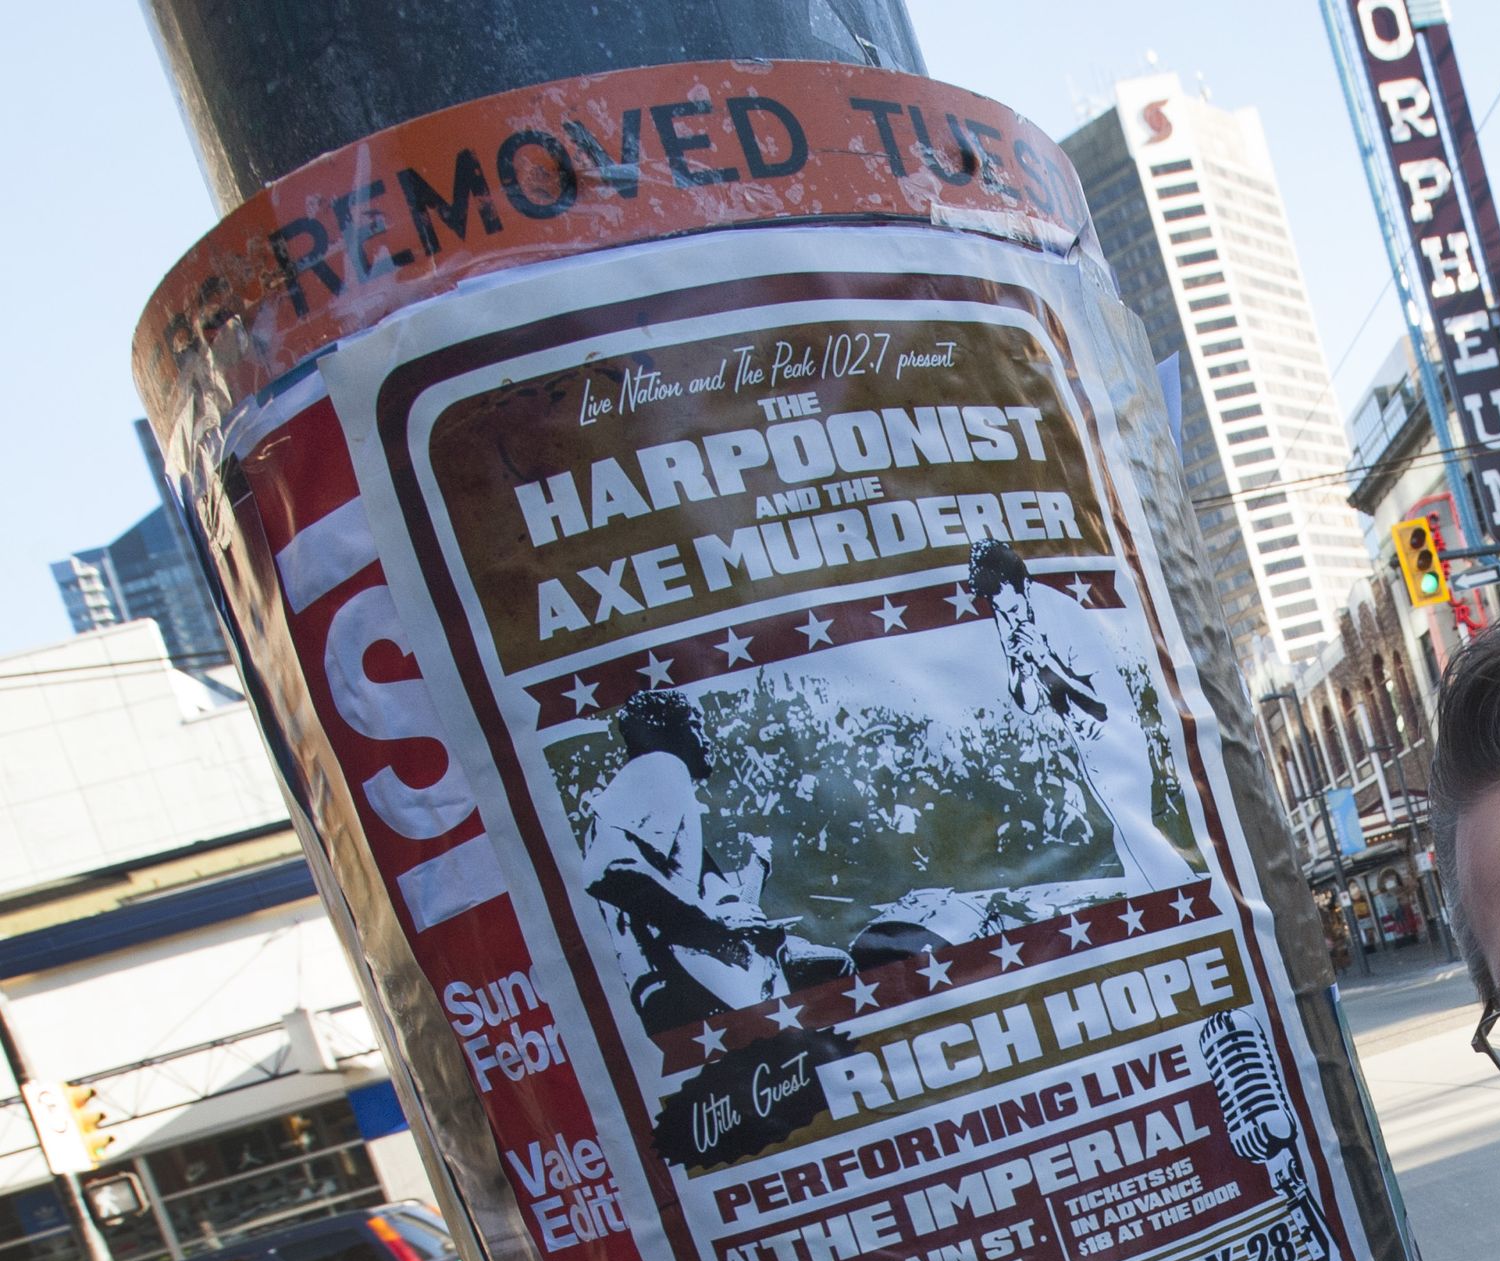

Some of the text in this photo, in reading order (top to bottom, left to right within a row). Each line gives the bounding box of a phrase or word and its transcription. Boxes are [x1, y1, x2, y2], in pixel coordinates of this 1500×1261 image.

[267, 95, 809, 318] REMOVED
[579, 333, 958, 427] Live Nation and The Peak 102.7 present
[757, 391, 823, 422] THE
[513, 405, 1048, 548] HARPOONIST
[755, 476, 884, 519] AND THE
[537, 491, 1084, 642] AXE MURDERER
[815, 951, 1237, 1121] RICH HOPE
[691, 1051, 812, 1152] With Guest
[710, 1044, 1192, 1225] PERFORMING LIVE
[903, 1100, 1211, 1237] IMPERIAL
[1070, 1175, 1203, 1238] IN ADVANCE
[1078, 1181, 1242, 1257] $18 AT THE DOOR
[980, 1218, 1048, 1261] ST.
